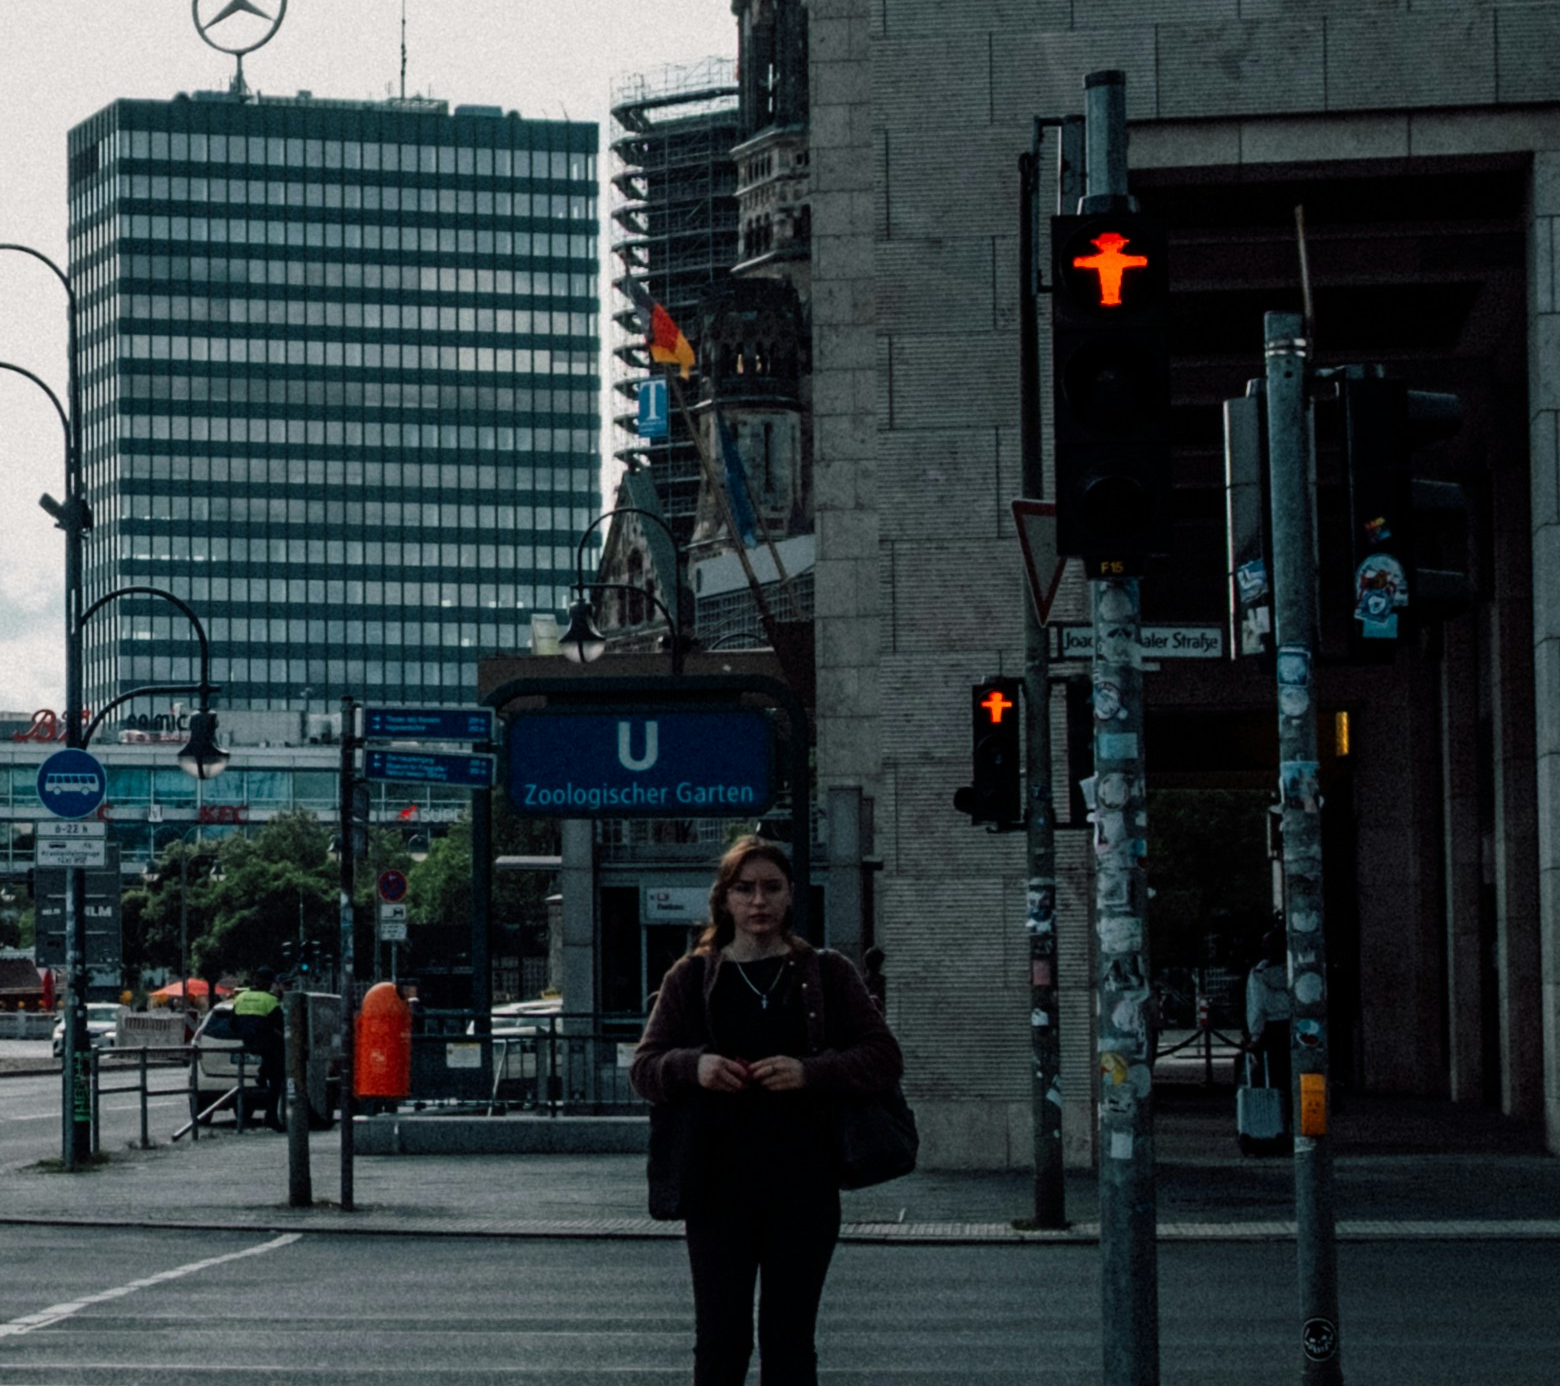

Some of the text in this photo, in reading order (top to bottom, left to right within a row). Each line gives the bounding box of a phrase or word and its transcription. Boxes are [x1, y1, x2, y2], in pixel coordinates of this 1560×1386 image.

[640, 379, 666, 421] T
[1099, 560, 1125, 575] F15
[1064, 630, 1219, 653] Joacaler Straße
[617, 720, 659, 772] U
[524, 781, 754, 810] Zoologischer Garten
